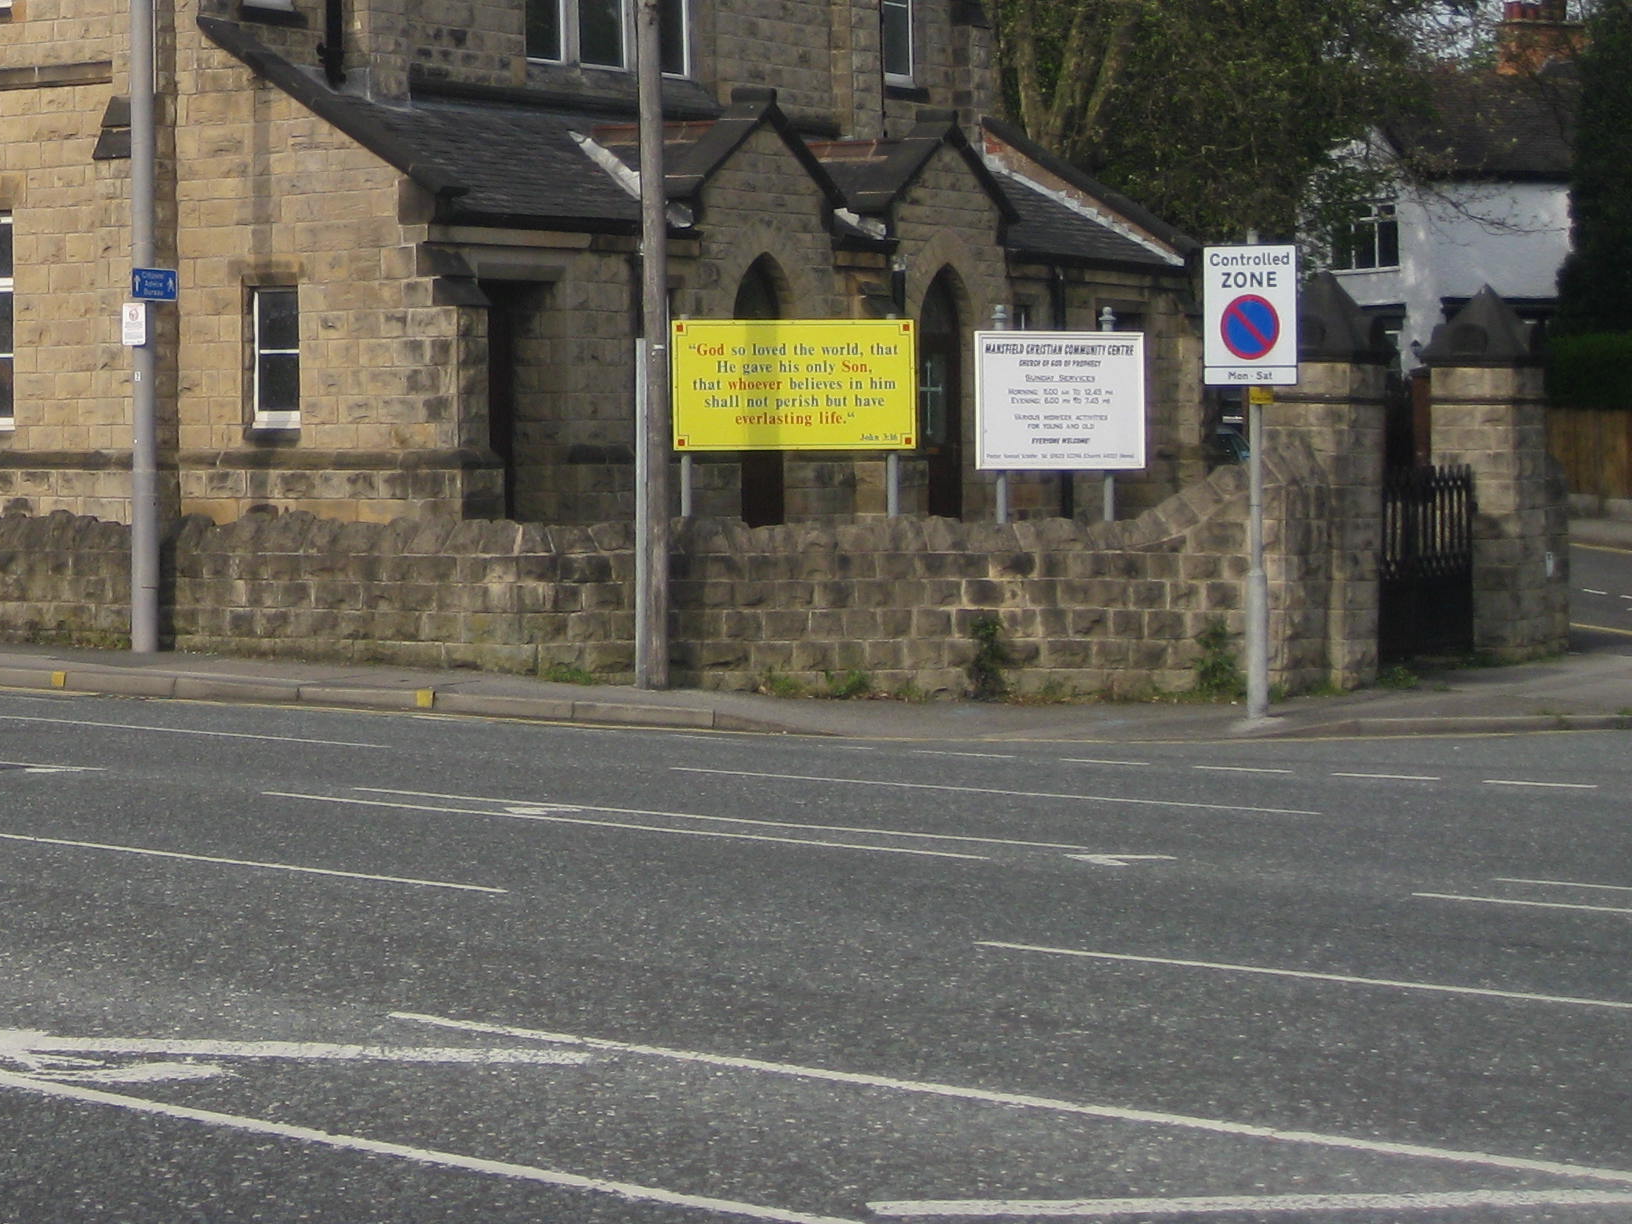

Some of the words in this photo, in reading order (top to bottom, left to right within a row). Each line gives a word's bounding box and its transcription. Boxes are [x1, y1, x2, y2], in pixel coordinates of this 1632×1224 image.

[1209, 252, 1290, 267] Controlled
[1221, 271, 1278, 288] ZONE
[731, 345, 746, 356] so
[752, 342, 787, 356] loved
[793, 343, 815, 356] the
[821, 342, 864, 357] world,
[870, 342, 898, 356] that
[984, 343, 1025, 355] MANSFIELD
[1025, 343, 1063, 355] CHRISTIAN
[1064, 344, 1107, 356] COMMUNITY
[1107, 344, 1135, 356] CENTRE
[716, 360, 736, 373] He
[742, 363, 772, 375] gave
[779, 360, 799, 373] his
[805, 360, 836, 375] only
[1019, 359, 1041, 367] CHURCH
[1042, 359, 1050, 367] OF
[1051, 359, 1063, 367] GOD
[1064, 359, 1071, 367] OF
[1072, 359, 1102, 368] PROPHECY
[1228, 371, 1248, 380] Mon
[1256, 371, 1273, 380] Sat
[692, 378, 721, 391] that
[727, 377, 783, 390] whoever
[789, 377, 843, 390] believes
[849, 377, 864, 390] in
[869, 377, 897, 390] him
[704, 395, 739, 408] shall
[746, 396, 769, 408] not
[775, 394, 819, 410] perish
[825, 394, 848, 407] but
[854, 394, 886, 407] have
[734, 411, 813, 426] everlasting
[859, 433, 880, 441] John
